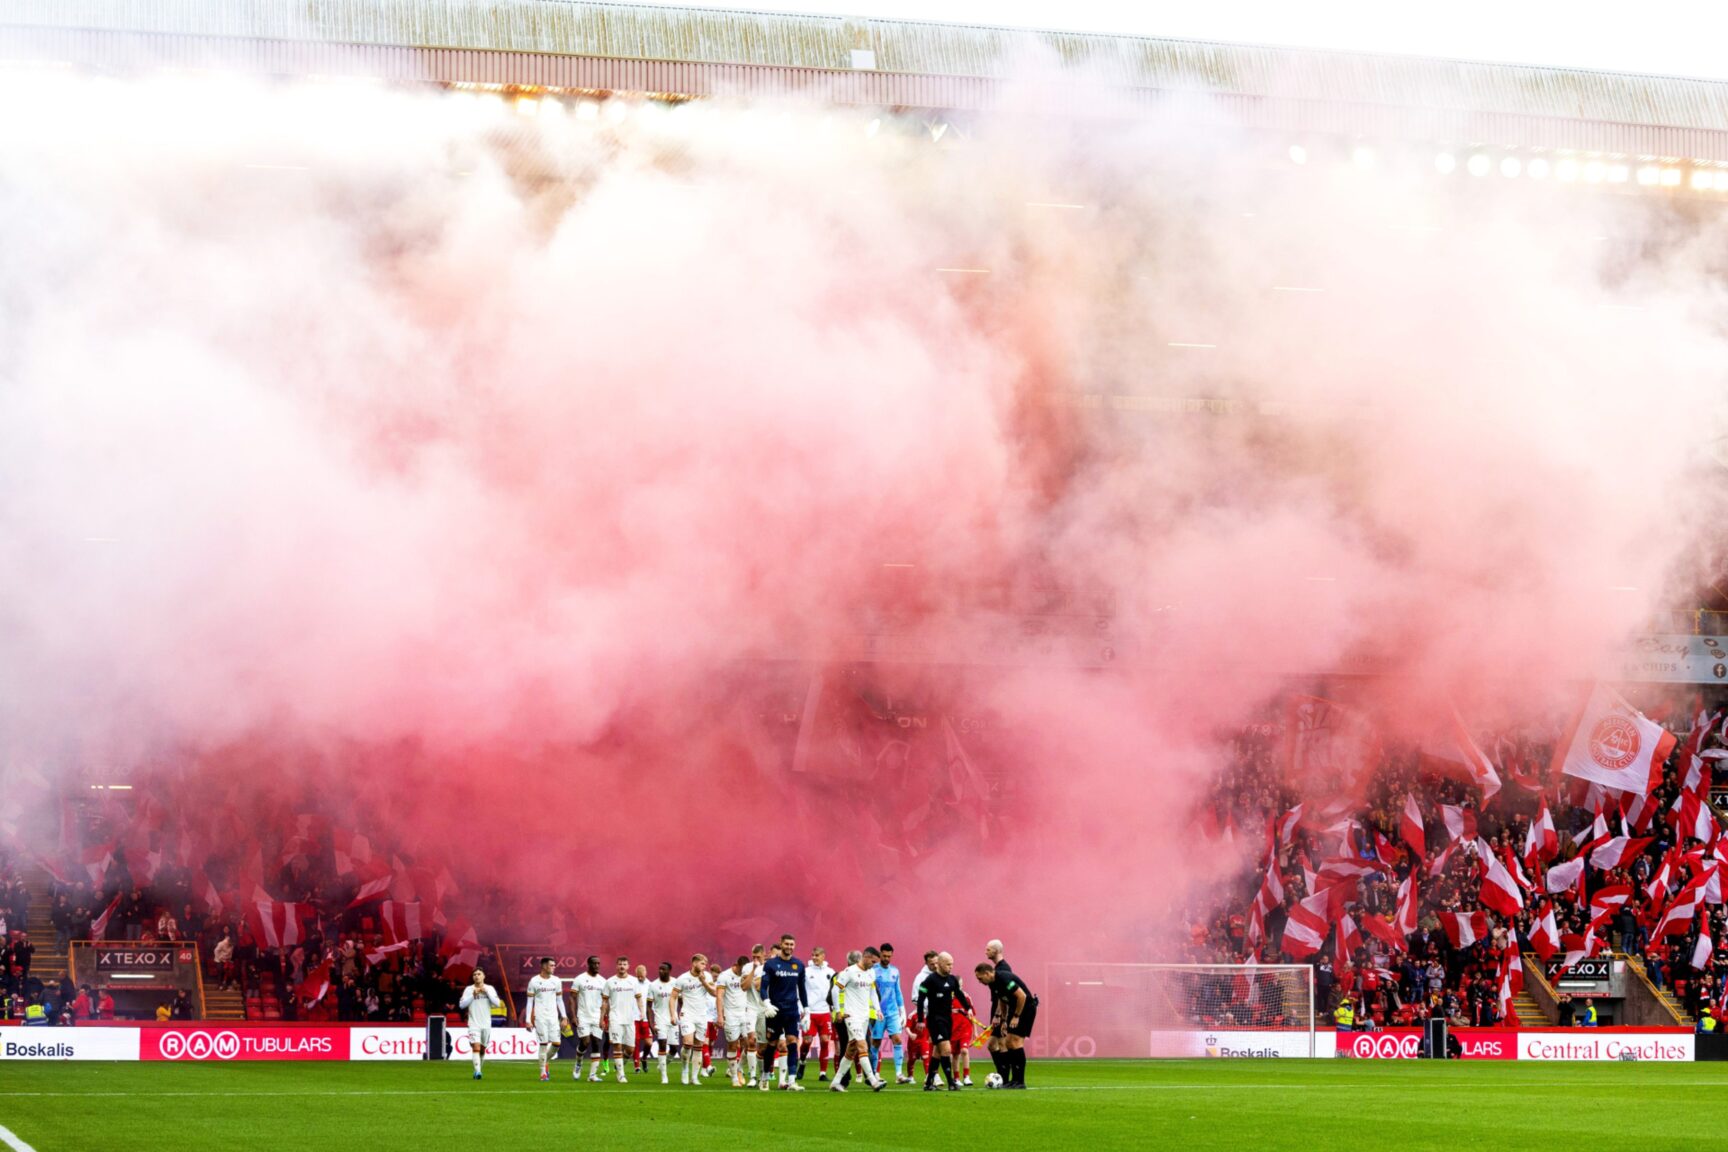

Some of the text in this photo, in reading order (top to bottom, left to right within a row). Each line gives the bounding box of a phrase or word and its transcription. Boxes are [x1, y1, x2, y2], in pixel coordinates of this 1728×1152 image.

[1642, 663, 1677, 673] CHIPS
[114, 953, 156, 964] TEXO
[179, 952, 192, 960] 40
[1560, 963, 1595, 974] EXO
[6, 1042, 74, 1057] Boskalis
[159, 1031, 332, 1059] RAM TUBULARS
[362, 1035, 538, 1055] Centr Cache
[1025, 1035, 1097, 1058] EXO
[1221, 1047, 1280, 1058] Boskalis
[1353, 1035, 1421, 1059] RAM
[1527, 1040, 1686, 1060] Central Coaches
